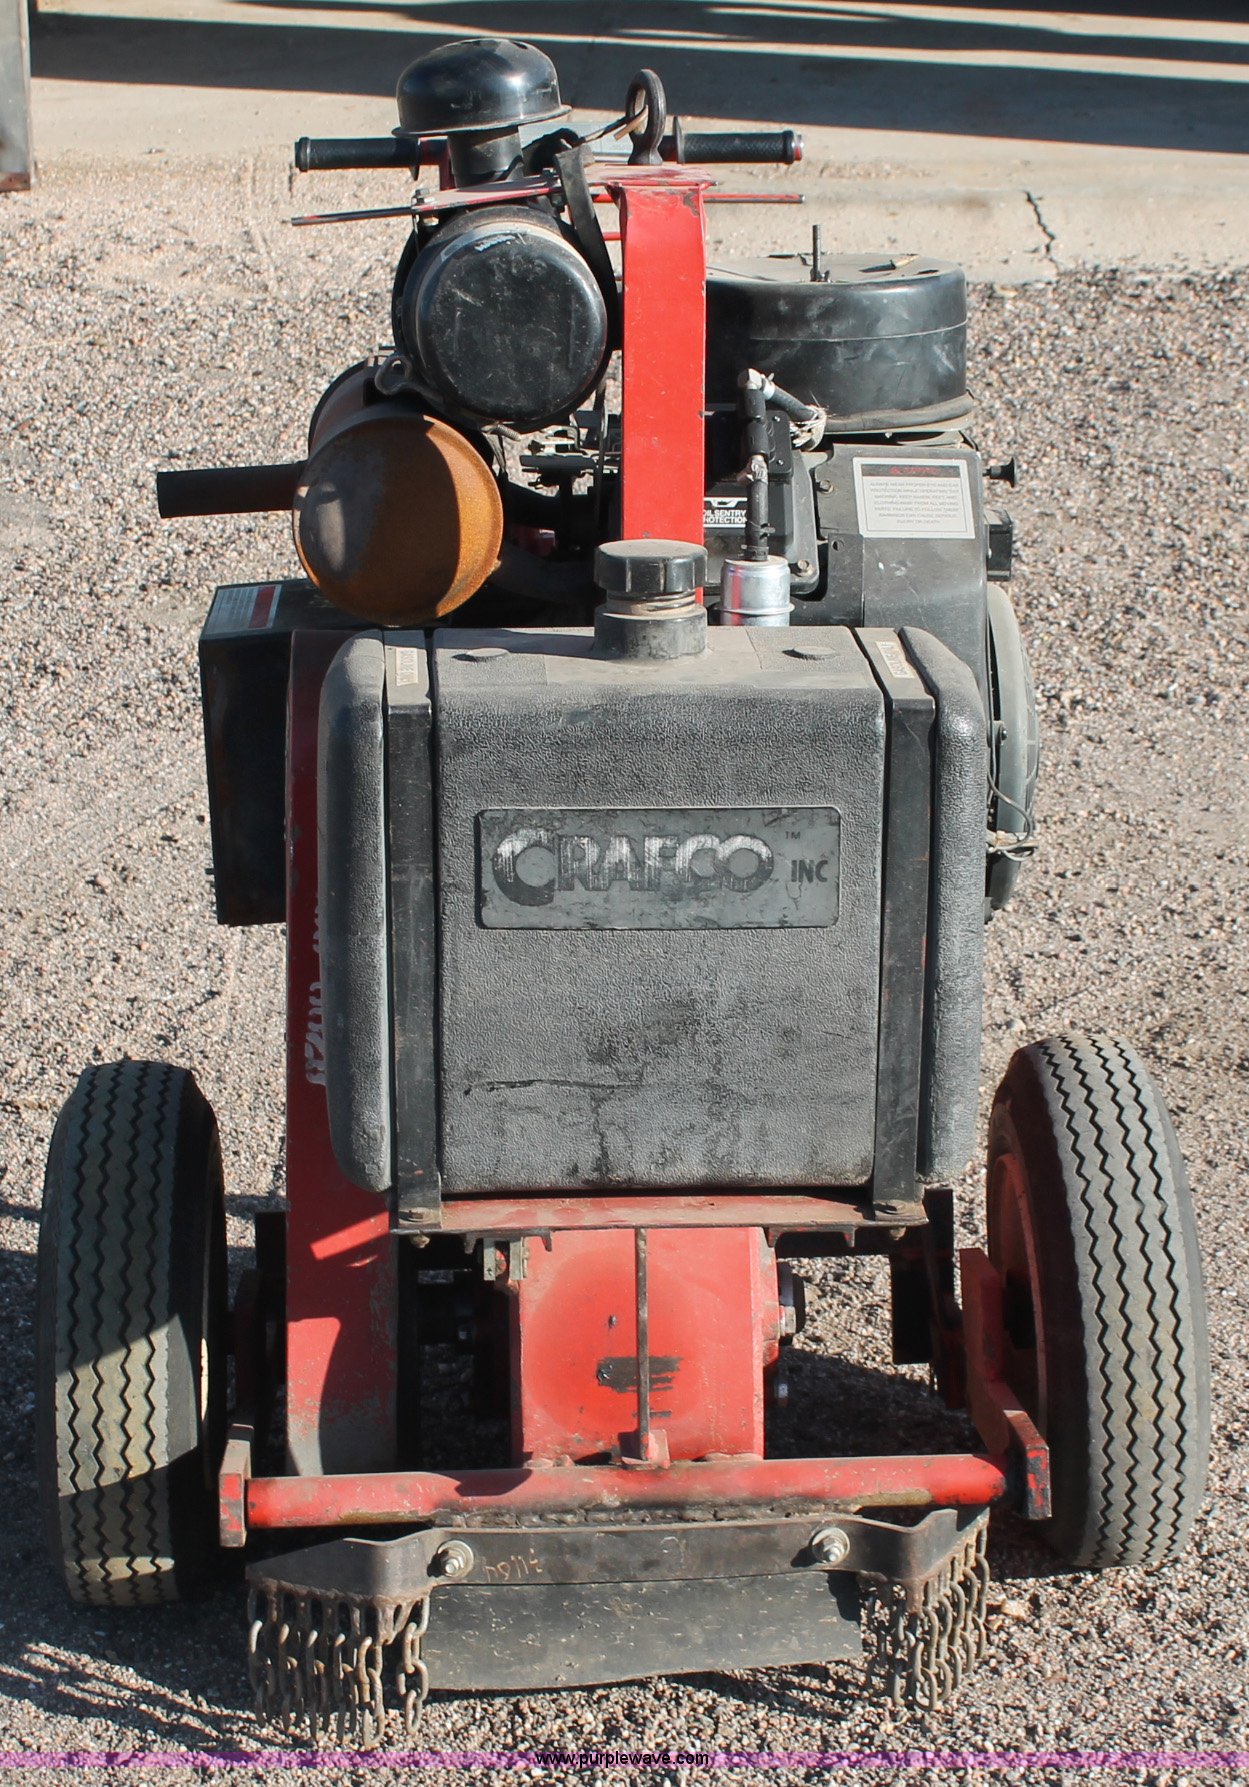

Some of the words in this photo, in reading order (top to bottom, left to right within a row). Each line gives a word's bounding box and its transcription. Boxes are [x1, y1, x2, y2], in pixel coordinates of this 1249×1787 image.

[703, 516, 748, 524] ROTECTION
[491, 828, 774, 907] CRAFCO
[791, 860, 828, 883] INC
